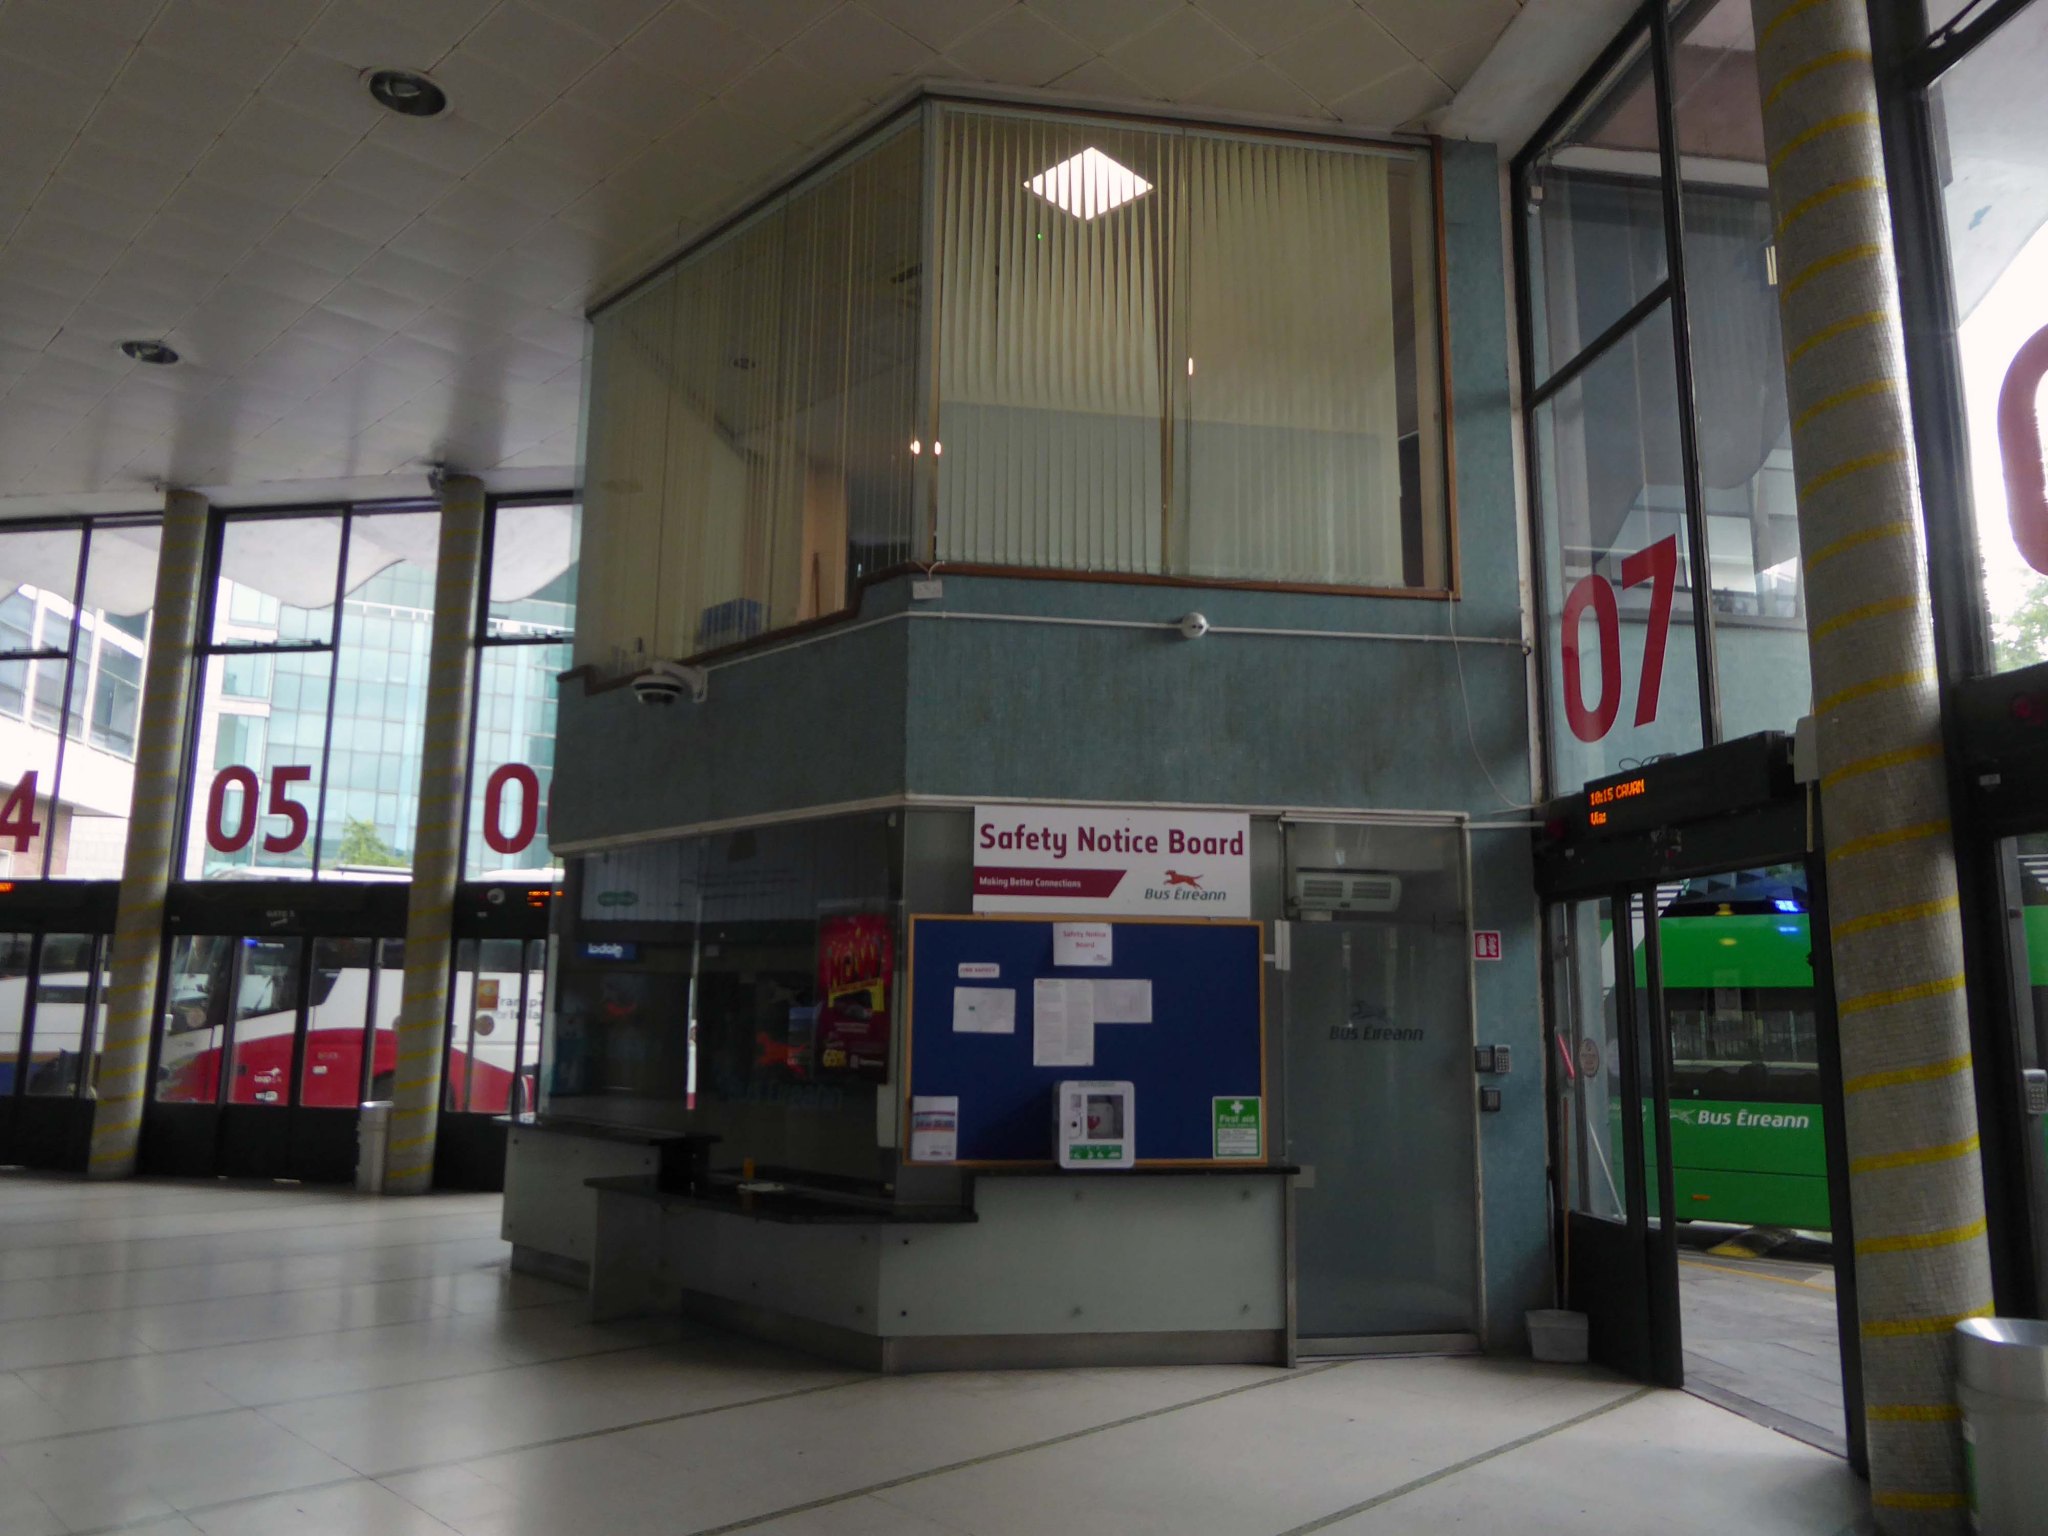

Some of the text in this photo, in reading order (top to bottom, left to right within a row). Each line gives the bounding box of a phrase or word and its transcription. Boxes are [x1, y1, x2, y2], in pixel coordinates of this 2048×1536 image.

[1562, 535, 1677, 742] 07
[1616, 778, 1645, 800] CAVAN
[206, 766, 310, 853] 05
[483, 763, 552, 854] 0
[979, 823, 1244, 859] Safety Notice Board
[979, 876, 1081, 889] Making Better Connections
[1144, 886, 1227, 902] Bus Éireann
[1062, 930, 1084, 939] Safety
[1075, 941, 1095, 949] Board
[1329, 1024, 1424, 1042] Bus Éireann
[1697, 1108, 1810, 1129] Bus Éireann
